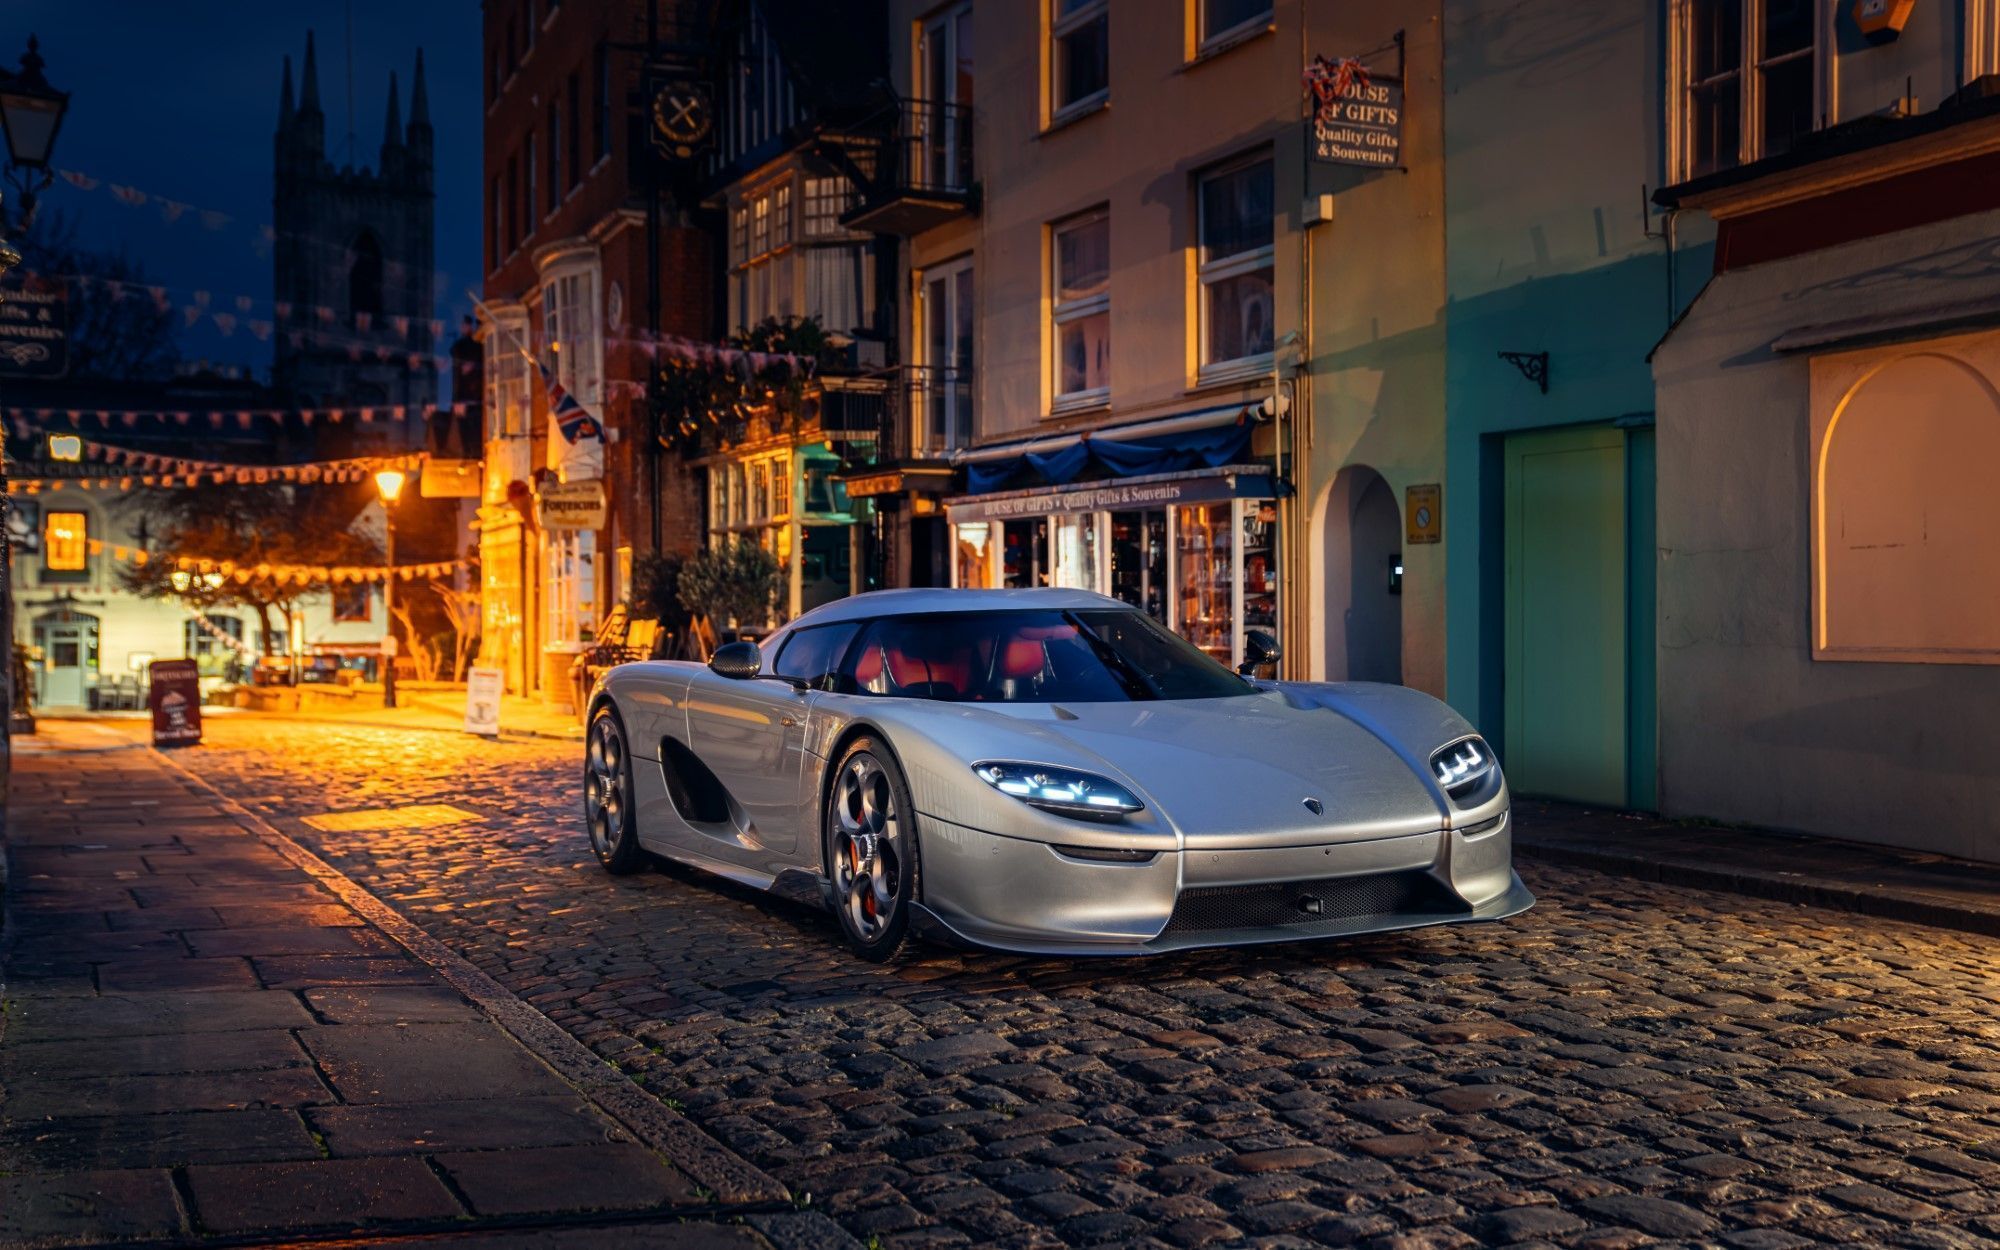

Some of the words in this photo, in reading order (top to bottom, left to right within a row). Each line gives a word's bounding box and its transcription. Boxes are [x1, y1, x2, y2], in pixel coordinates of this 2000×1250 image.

[1342, 83, 1389, 103] OUSE
[1346, 103, 1398, 125] GIFTS
[1315, 127, 1364, 145] Quality
[1366, 131, 1398, 148] Gifts
[1318, 143, 1328, 156] &
[1331, 144, 1394, 163] Souvenirs
[984, 499, 1013, 516] HOUSE
[1013, 501, 1025, 513] OF
[1026, 498, 1054, 512] GIFTS
[1063, 493, 1095, 511] Quality
[1096, 488, 1120, 505] Gifts
[1121, 488, 1130, 502] &
[1131, 484, 1181, 502] Souvenirs
